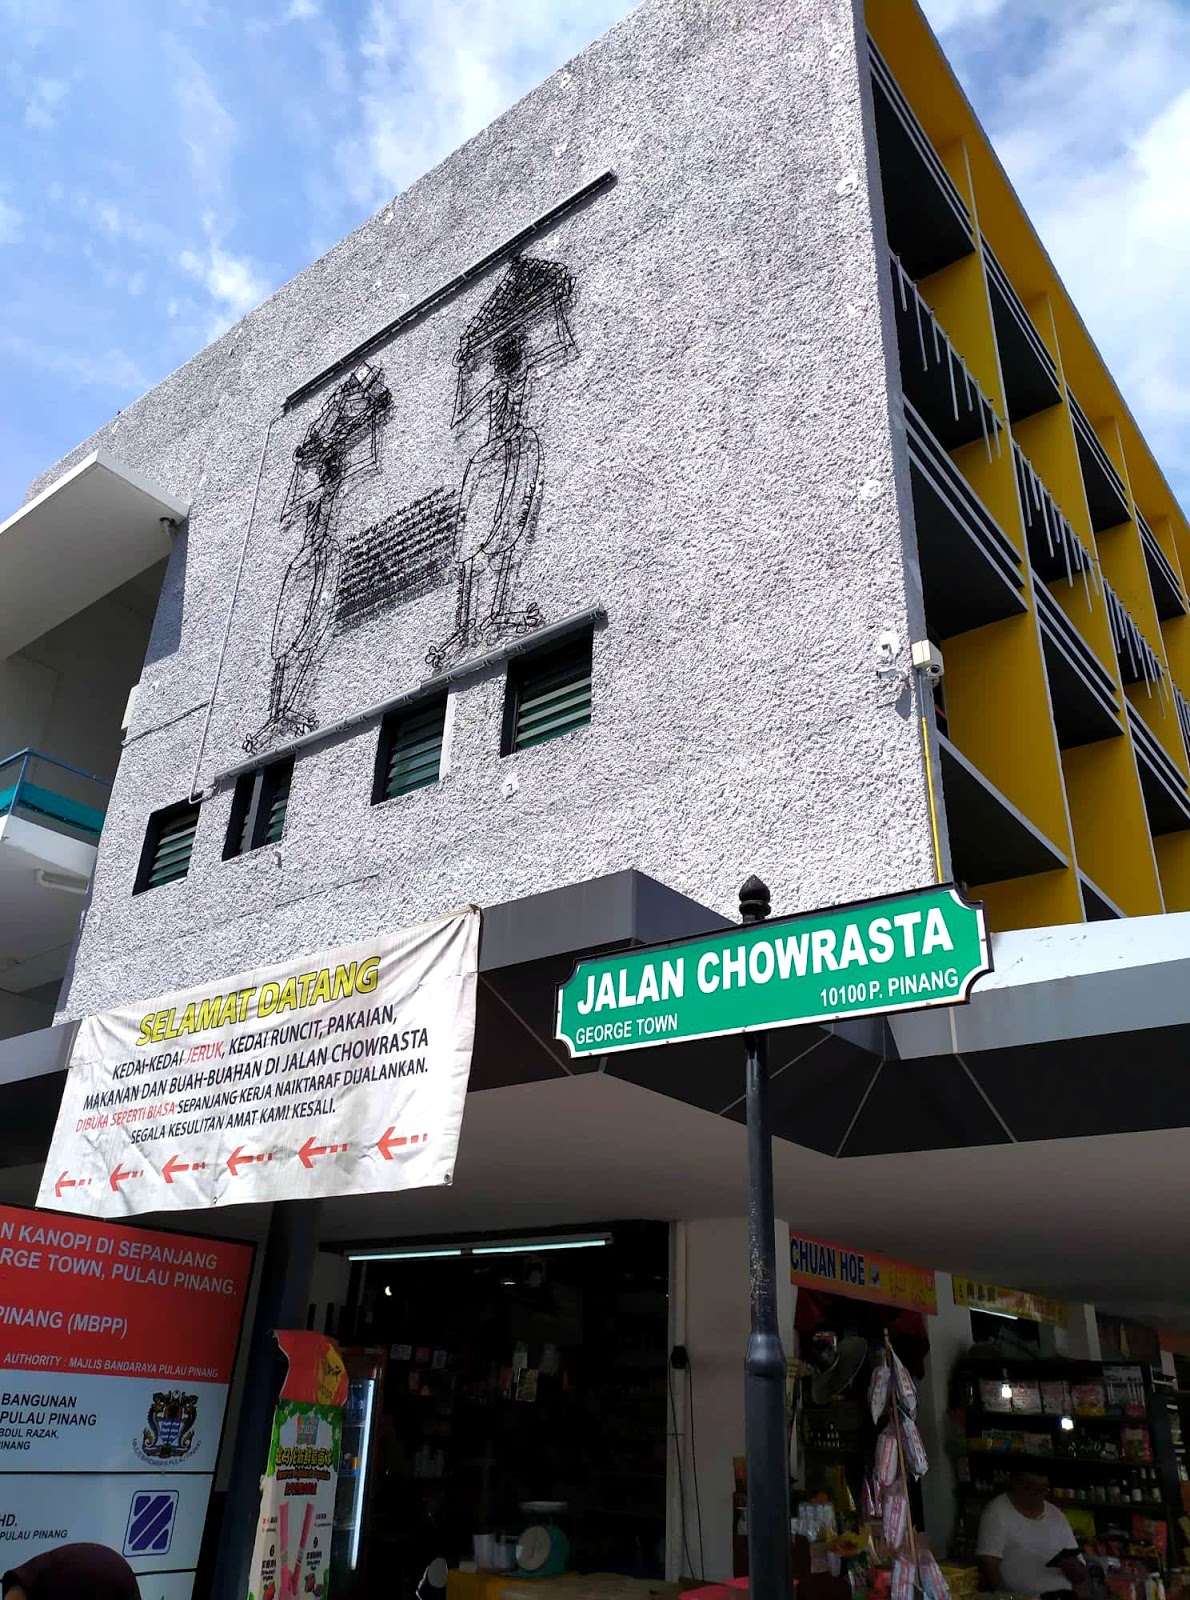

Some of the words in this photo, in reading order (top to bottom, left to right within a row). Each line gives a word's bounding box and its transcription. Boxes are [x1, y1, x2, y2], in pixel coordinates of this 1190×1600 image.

[576, 958, 685, 1015] JALAN
[697, 907, 954, 994] CHOWRASTA
[135, 986, 256, 1047] SELAMAT
[257, 956, 382, 1020] DATANG
[820, 982, 866, 1008] 10100
[869, 980, 883, 1001] P.
[888, 967, 959, 998] PINANG
[112, 1050, 184, 1080] KEDAI-KEDAI
[184, 1040, 225, 1065] JERUK,
[229, 1032, 268, 1055] KEDAI
[271, 1020, 323, 1047] RUNCIT,
[327, 1004, 397, 1035] PAKAIAN,
[576, 1020, 632, 1045] GEORGE
[636, 1013, 678, 1036] TOWN
[83, 1086, 140, 1111] MAKANAN
[141, 1079, 168, 1099] DAN
[169, 1060, 262, 1095] BUAH-BUAHAN
[265, 1056, 280, 1076] DI
[282, 1047, 327, 1073] JALAN
[331, 1028, 429, 1063] CHOWRASTA
[75, 1115, 109, 1133] DIBUKA
[110, 1106, 145, 1126] SEPERTI
[147, 1102, 176, 1120] BIASA
[177, 1090, 237, 1114] SEPANJANG
[239, 1084, 272, 1104] KERJA
[274, 1071, 341, 1098] NAIKTARAF
[343, 1057, 428, 1087] DIJALANKAN.
[130, 1124, 165, 1145] SEGALA
[168, 1115, 224, 1138] KESULITAN
[225, 1109, 259, 1129] AMAT
[260, 1103, 290, 1124] KAMI
[291, 1098, 336, 1120] KESALI.
[18, 1225, 91, 1252] KANOPI
[96, 1237, 114, 1254] DI
[118, 1241, 218, 1270] SEPANJANG
[790, 1238, 836, 1279] CHUAN
[840, 1250, 865, 1286] HOE
[48, 1254, 106, 1281] TOWN,
[112, 1263, 170, 1287] PULAU
[174, 1273, 237, 1296] PINANG.
[67, 1313, 128, 1340] (MBPP)
[4, 1353, 62, 1368] AUTHORITY
[68, 1357, 102, 1370] MAJLIS
[104, 1360, 157, 1373] BANDARAYA
[159, 1364, 187, 1377] PULAU
[188, 1366, 218, 1378] PINANG
[0, 1411, 45, 1424] PULAU
[48, 1412, 97, 1427] PINANG
[1, 1393, 77, 1408] BANGUNAN
[0, 1441, 30, 1450] INANG
[25, 1428, 60, 1440] RAZAK,
[0, 1531, 31, 1541] PULAU
[33, 1529, 67, 1540] PINANG
